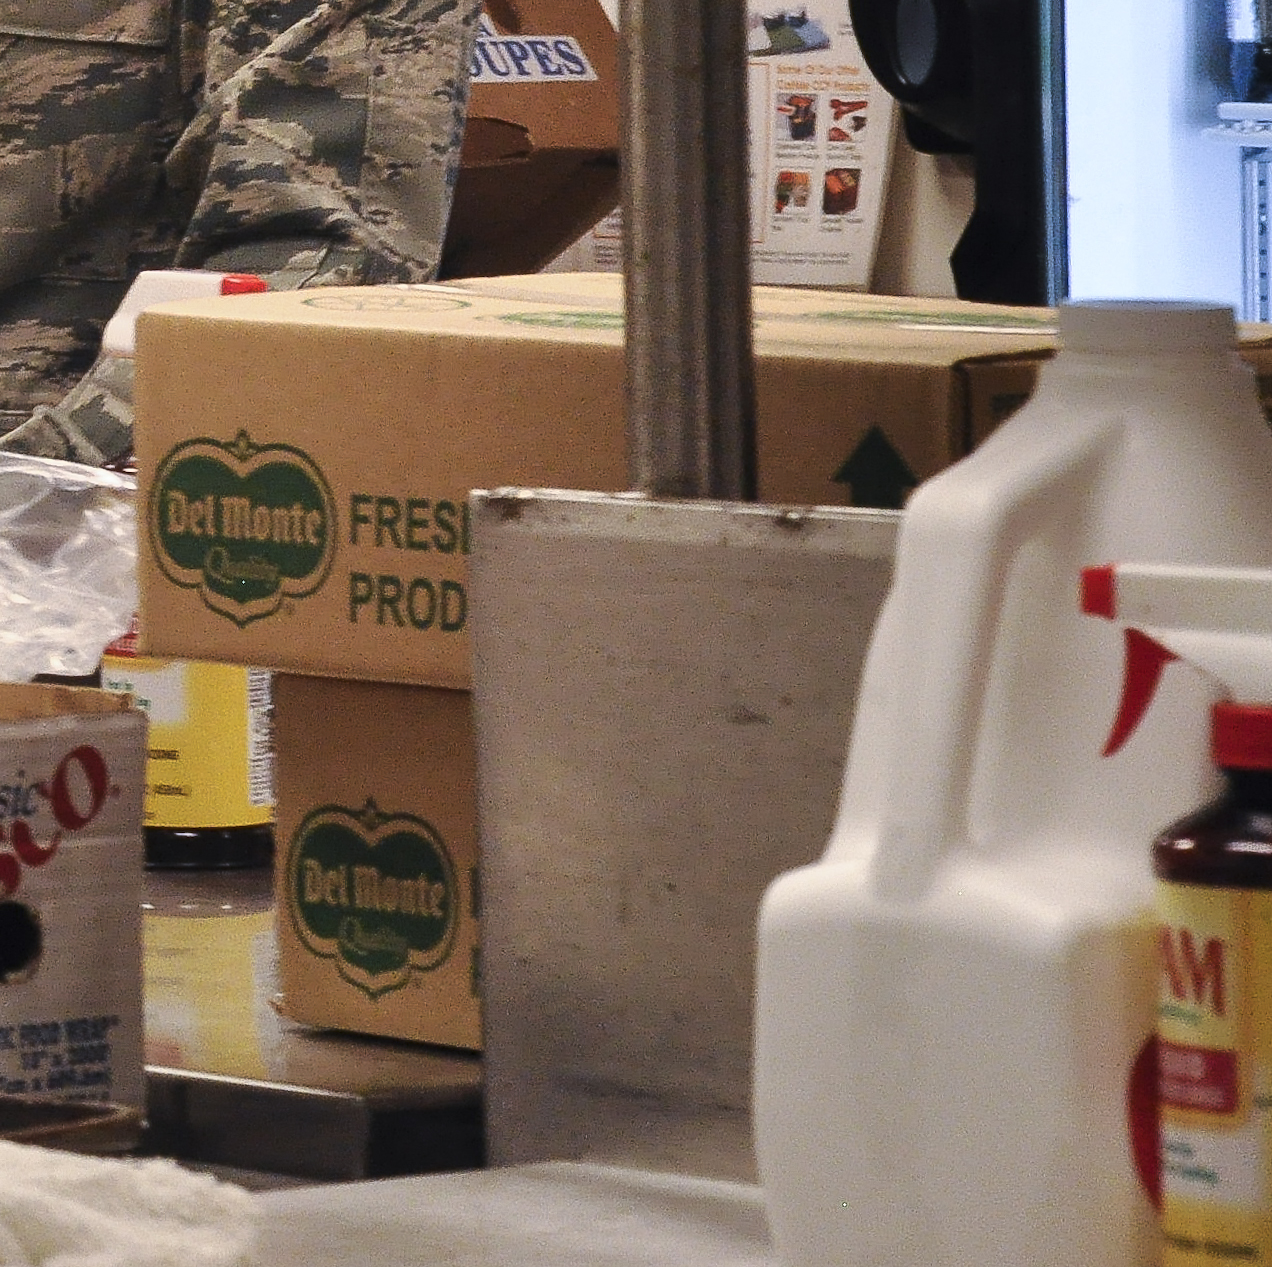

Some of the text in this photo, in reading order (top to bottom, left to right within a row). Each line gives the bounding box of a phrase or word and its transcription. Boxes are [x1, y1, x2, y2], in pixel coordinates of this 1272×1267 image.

[168, 490, 325, 546] Del Monte
[350, 572, 469, 633] PROD
[304, 859, 446, 918] Del Monte
